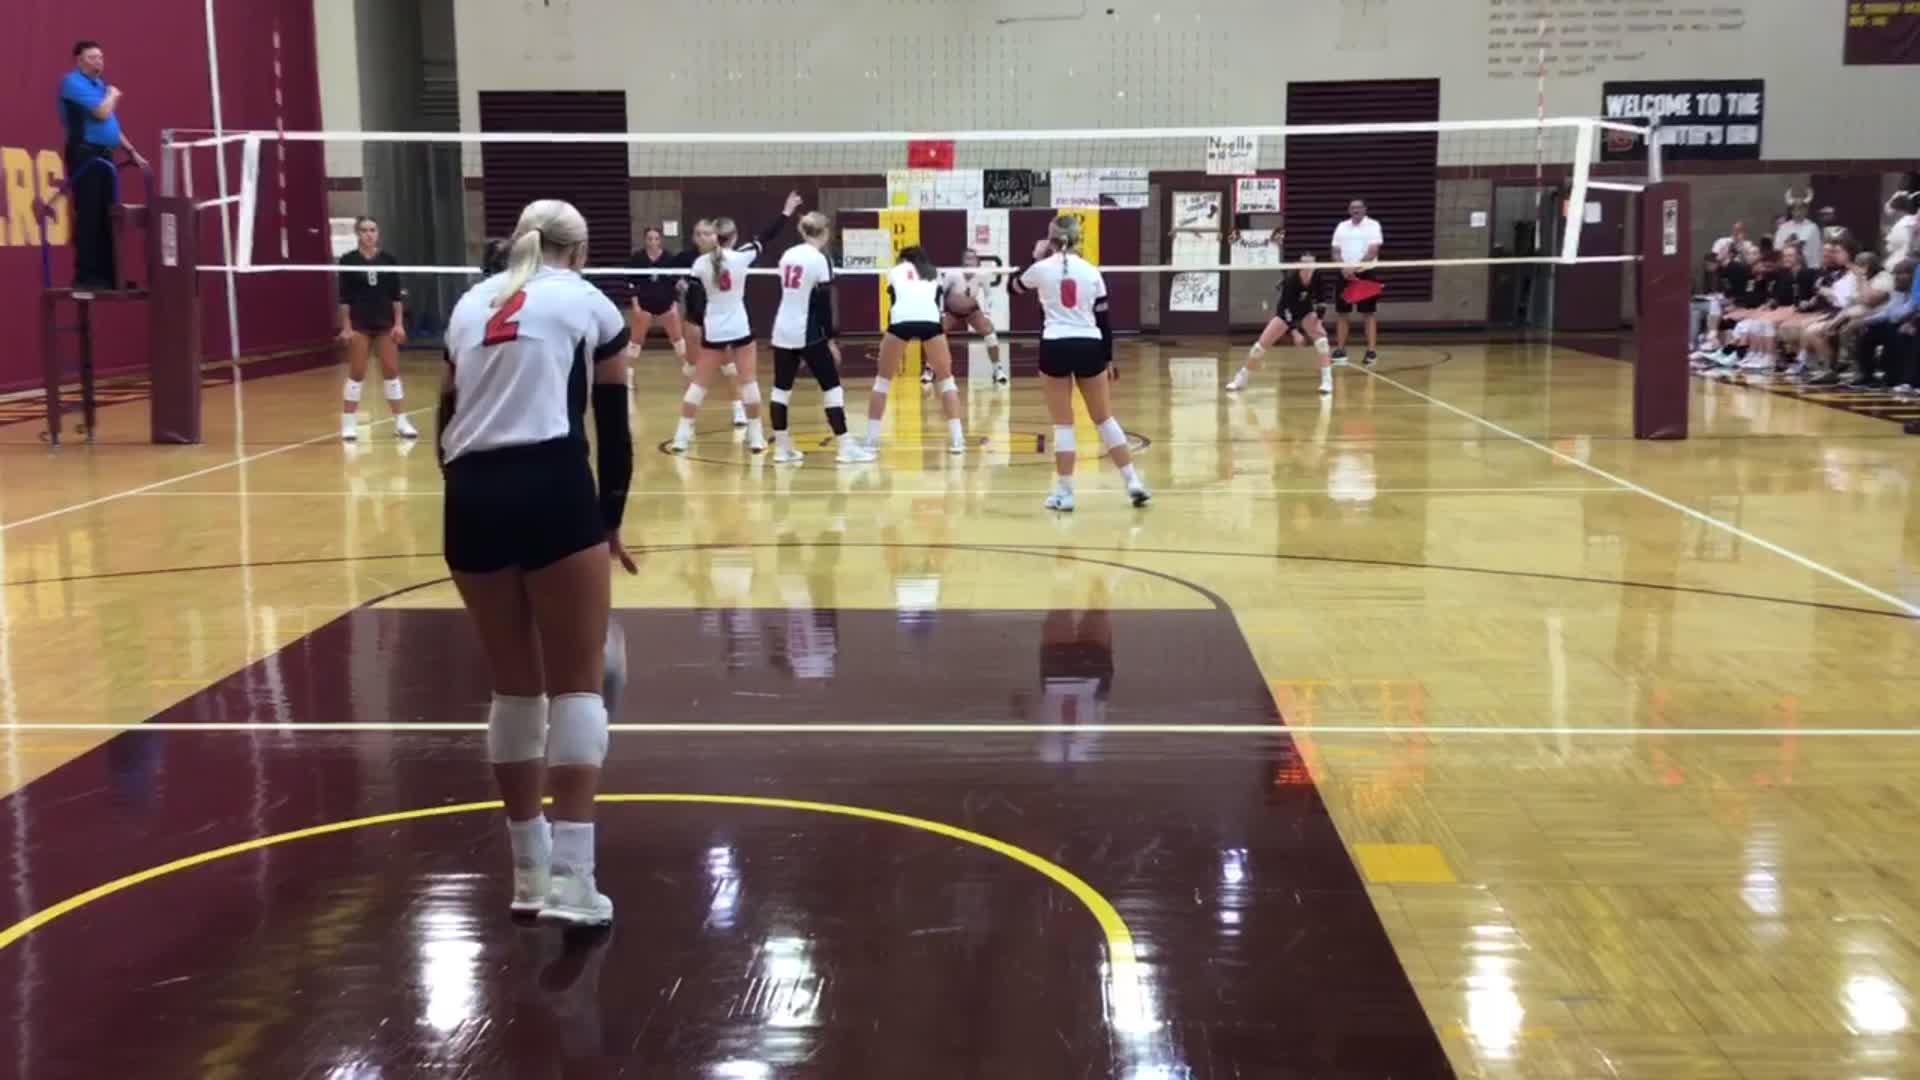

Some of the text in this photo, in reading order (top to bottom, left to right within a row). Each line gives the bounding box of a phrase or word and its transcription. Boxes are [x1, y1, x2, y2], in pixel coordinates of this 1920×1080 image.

[1606, 93, 1760, 118] WELCOME TO THE
[0, 146, 70, 246] RS
[783, 264, 804, 289] 12
[482, 288, 528, 347] 2
